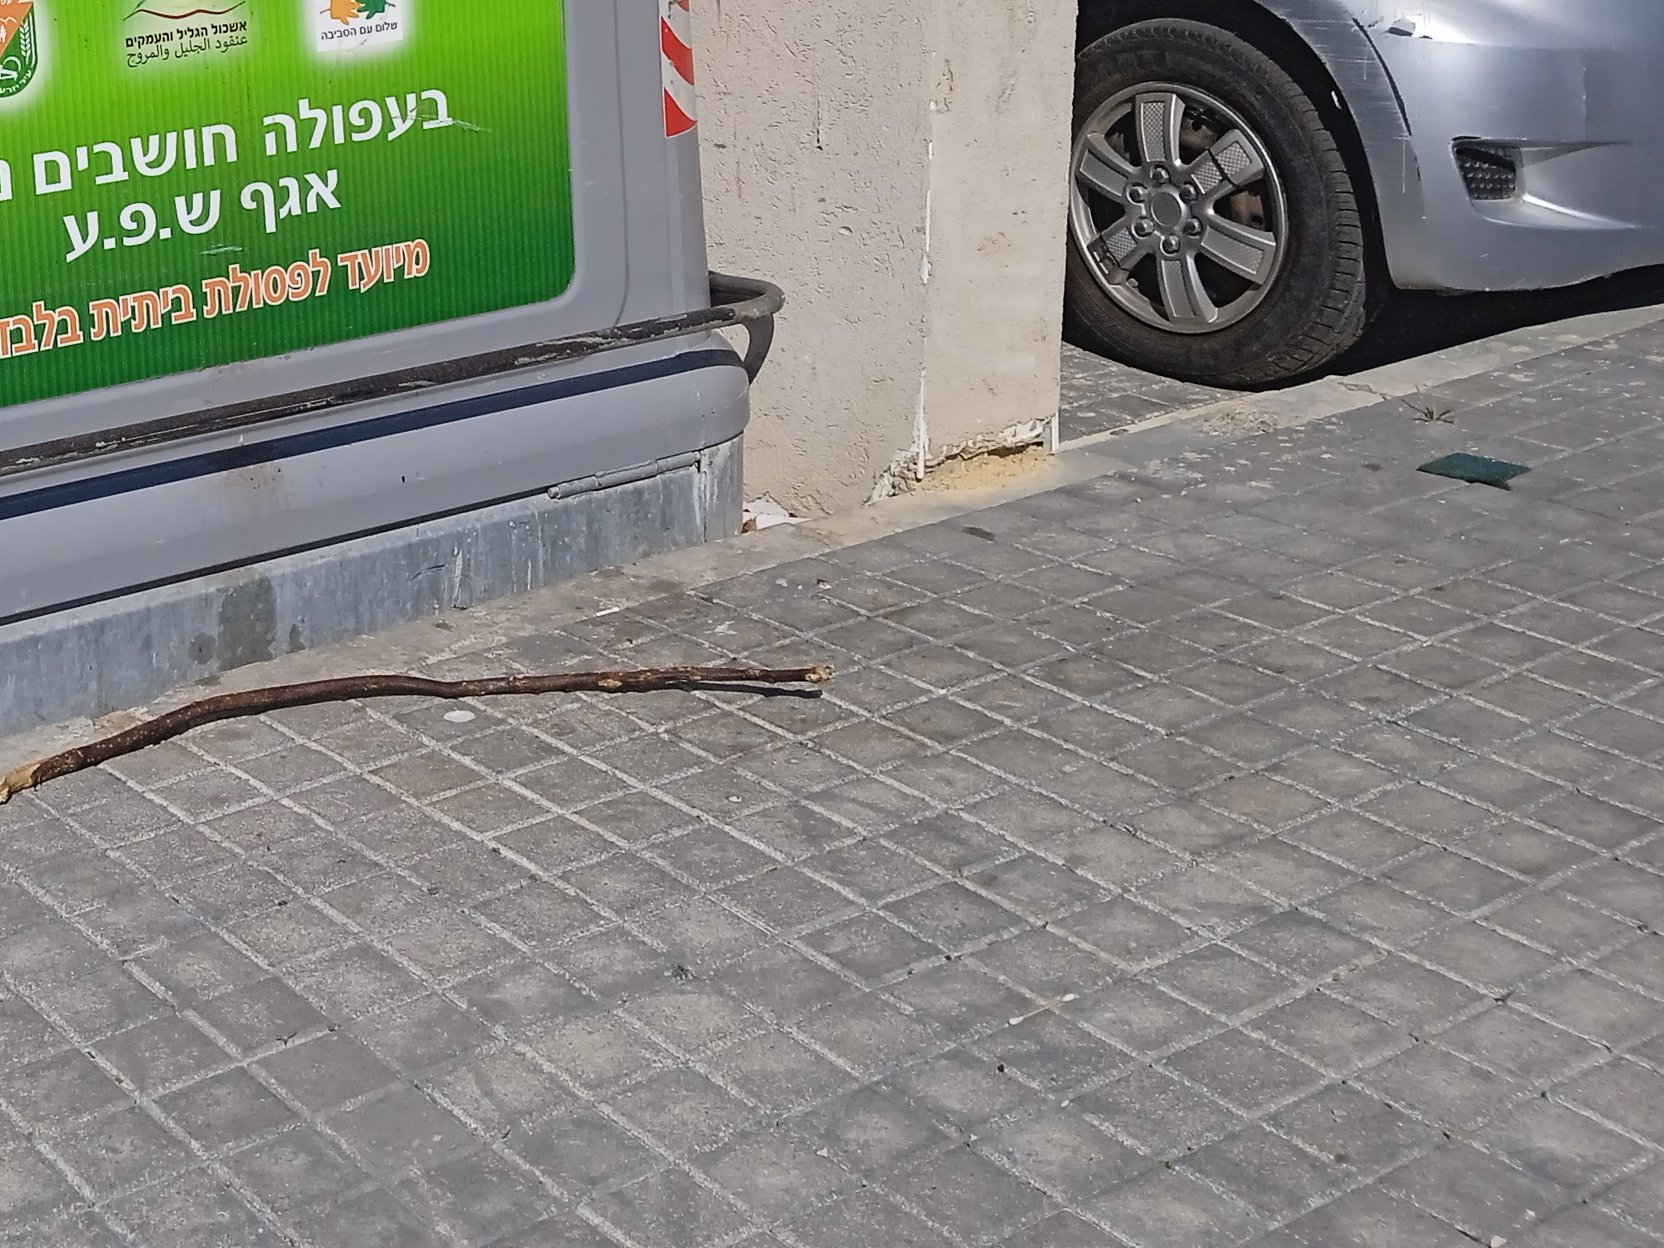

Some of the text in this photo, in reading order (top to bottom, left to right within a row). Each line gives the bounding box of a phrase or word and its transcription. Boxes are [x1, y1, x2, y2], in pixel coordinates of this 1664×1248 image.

[125, 20, 247, 49] אשכול הגליל והעמקים
[126, 35, 248, 68] عنقود الجليل والمروج
[321, 21, 398, 40] שלום עם הסביבה
[263, 87, 455, 157] בעפולה
[35, 119, 238, 197] חושבים
[61, 168, 342, 263] אגף ש.פ.ע
[202, 249, 332, 317] לפסולת
[337, 237, 431, 293] מיועד
[89, 284, 197, 342] ביתית
